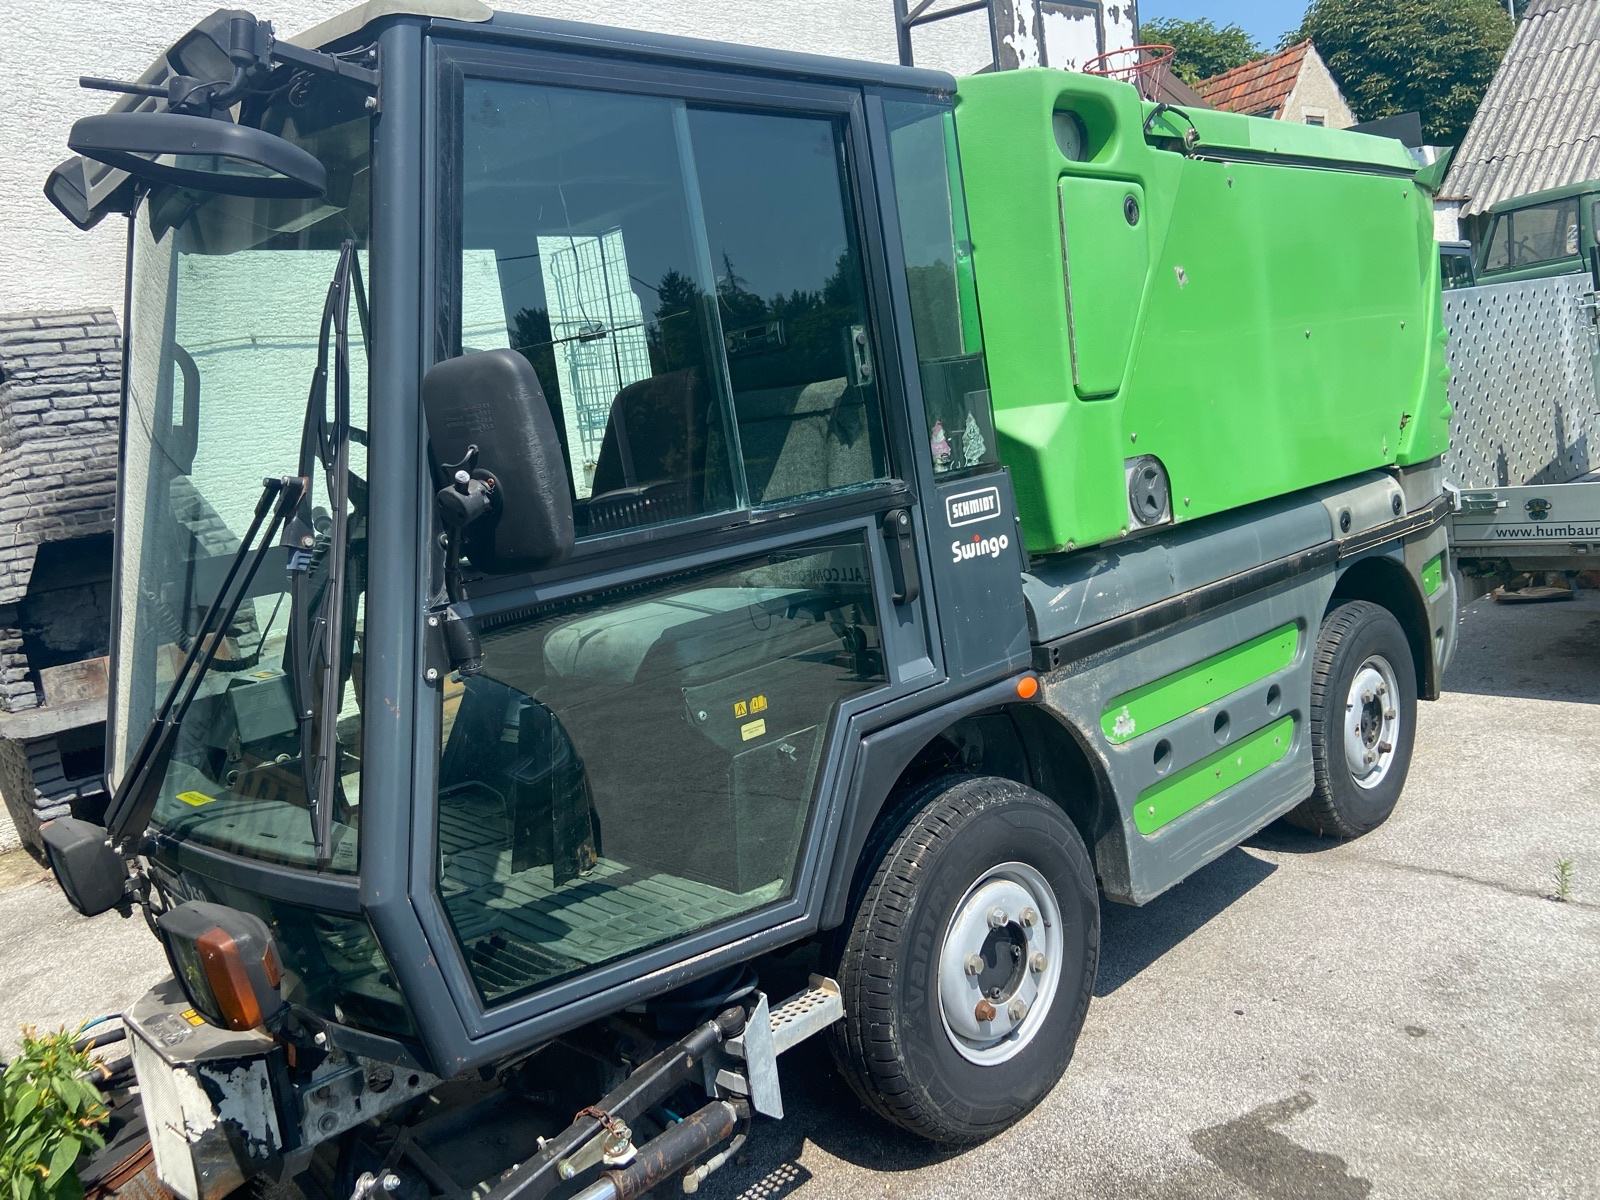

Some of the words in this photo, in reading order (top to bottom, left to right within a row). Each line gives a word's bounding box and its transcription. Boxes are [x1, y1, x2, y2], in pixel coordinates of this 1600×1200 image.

[952, 495, 995, 519] SCHMIDT
[1496, 524, 1600, 537] www.humbaur
[951, 534, 1009, 563] Swingo
